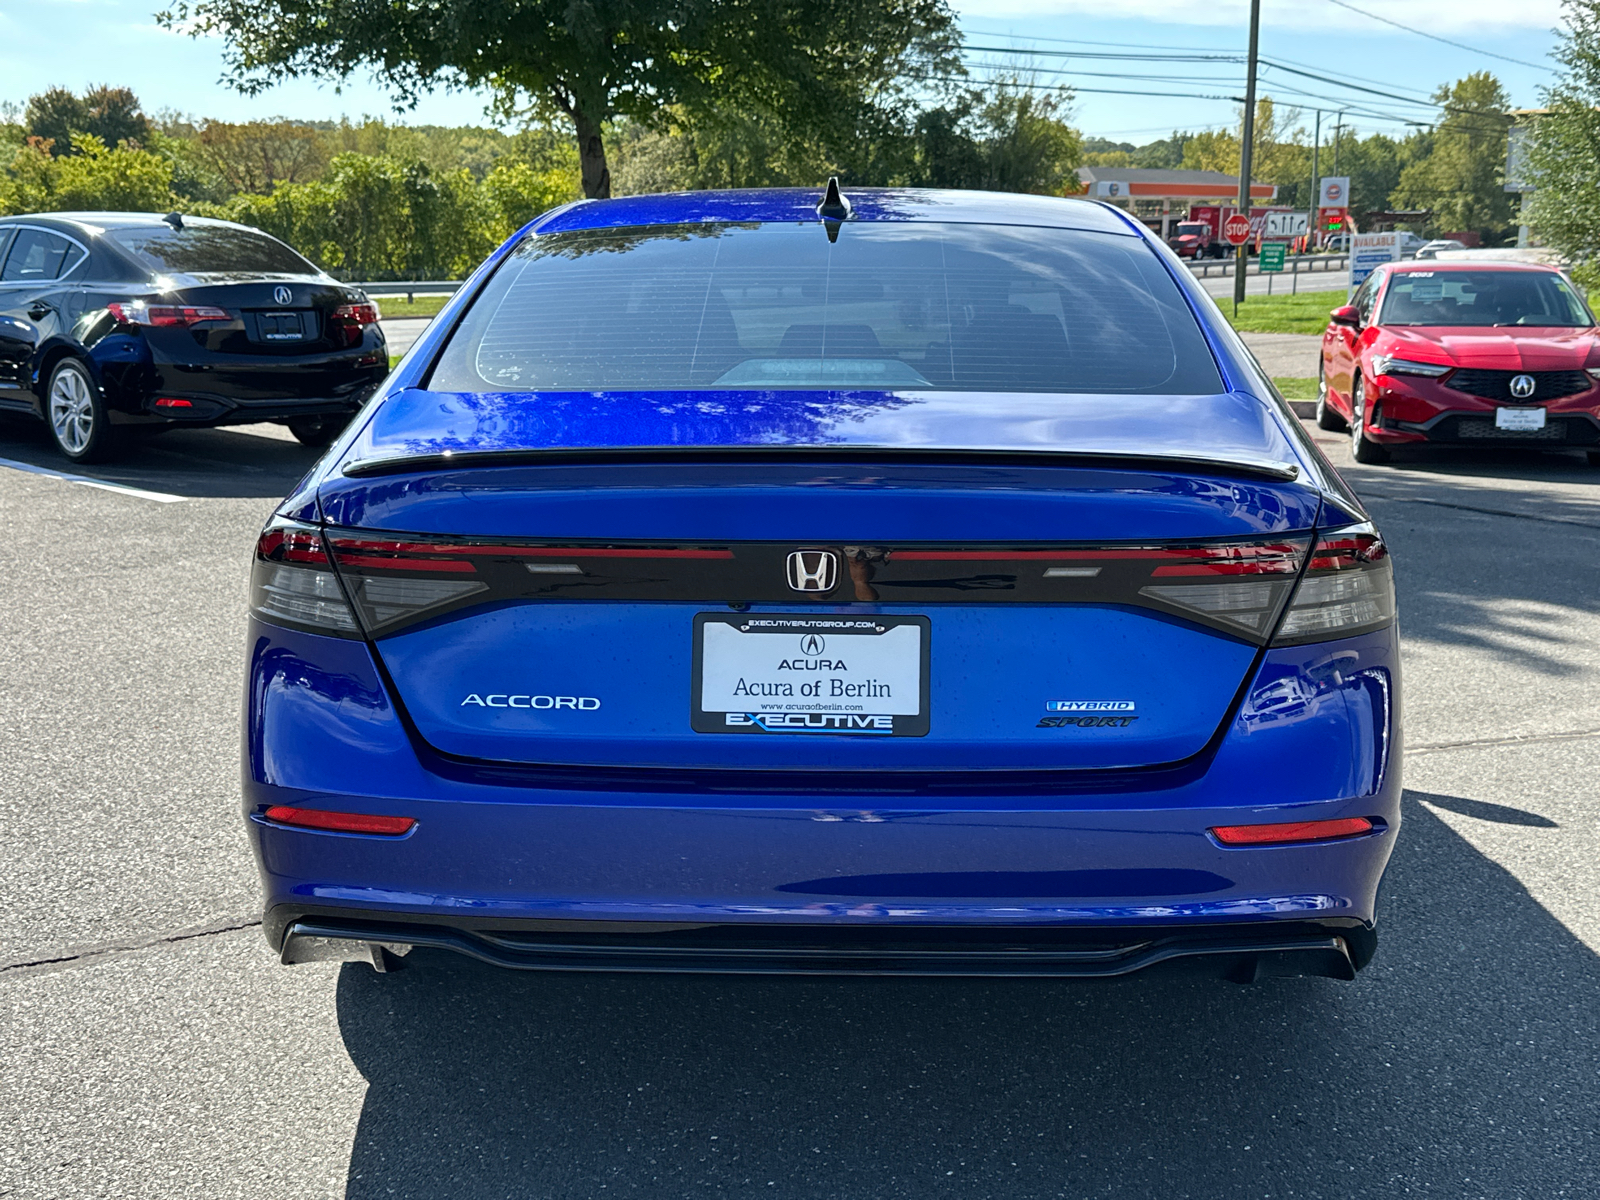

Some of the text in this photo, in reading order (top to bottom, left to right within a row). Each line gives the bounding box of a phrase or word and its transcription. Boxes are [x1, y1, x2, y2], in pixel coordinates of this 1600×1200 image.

[1226, 223, 1249, 236] STOP
[1353, 236, 1396, 248] AVAILABLE
[747, 619, 876, 629] EXECUTIVEAUTOGROUP.COM
[777, 659, 848, 671] ACURA
[733, 677, 892, 698] Acura of Berlin
[460, 693, 602, 711] ACCORD
[760, 702, 864, 712] www.acuraofberlin.com
[1059, 702, 1130, 710] HYBRID
[725, 713, 894, 731] EXECUTIVE
[1035, 715, 1140, 728] SPORT
